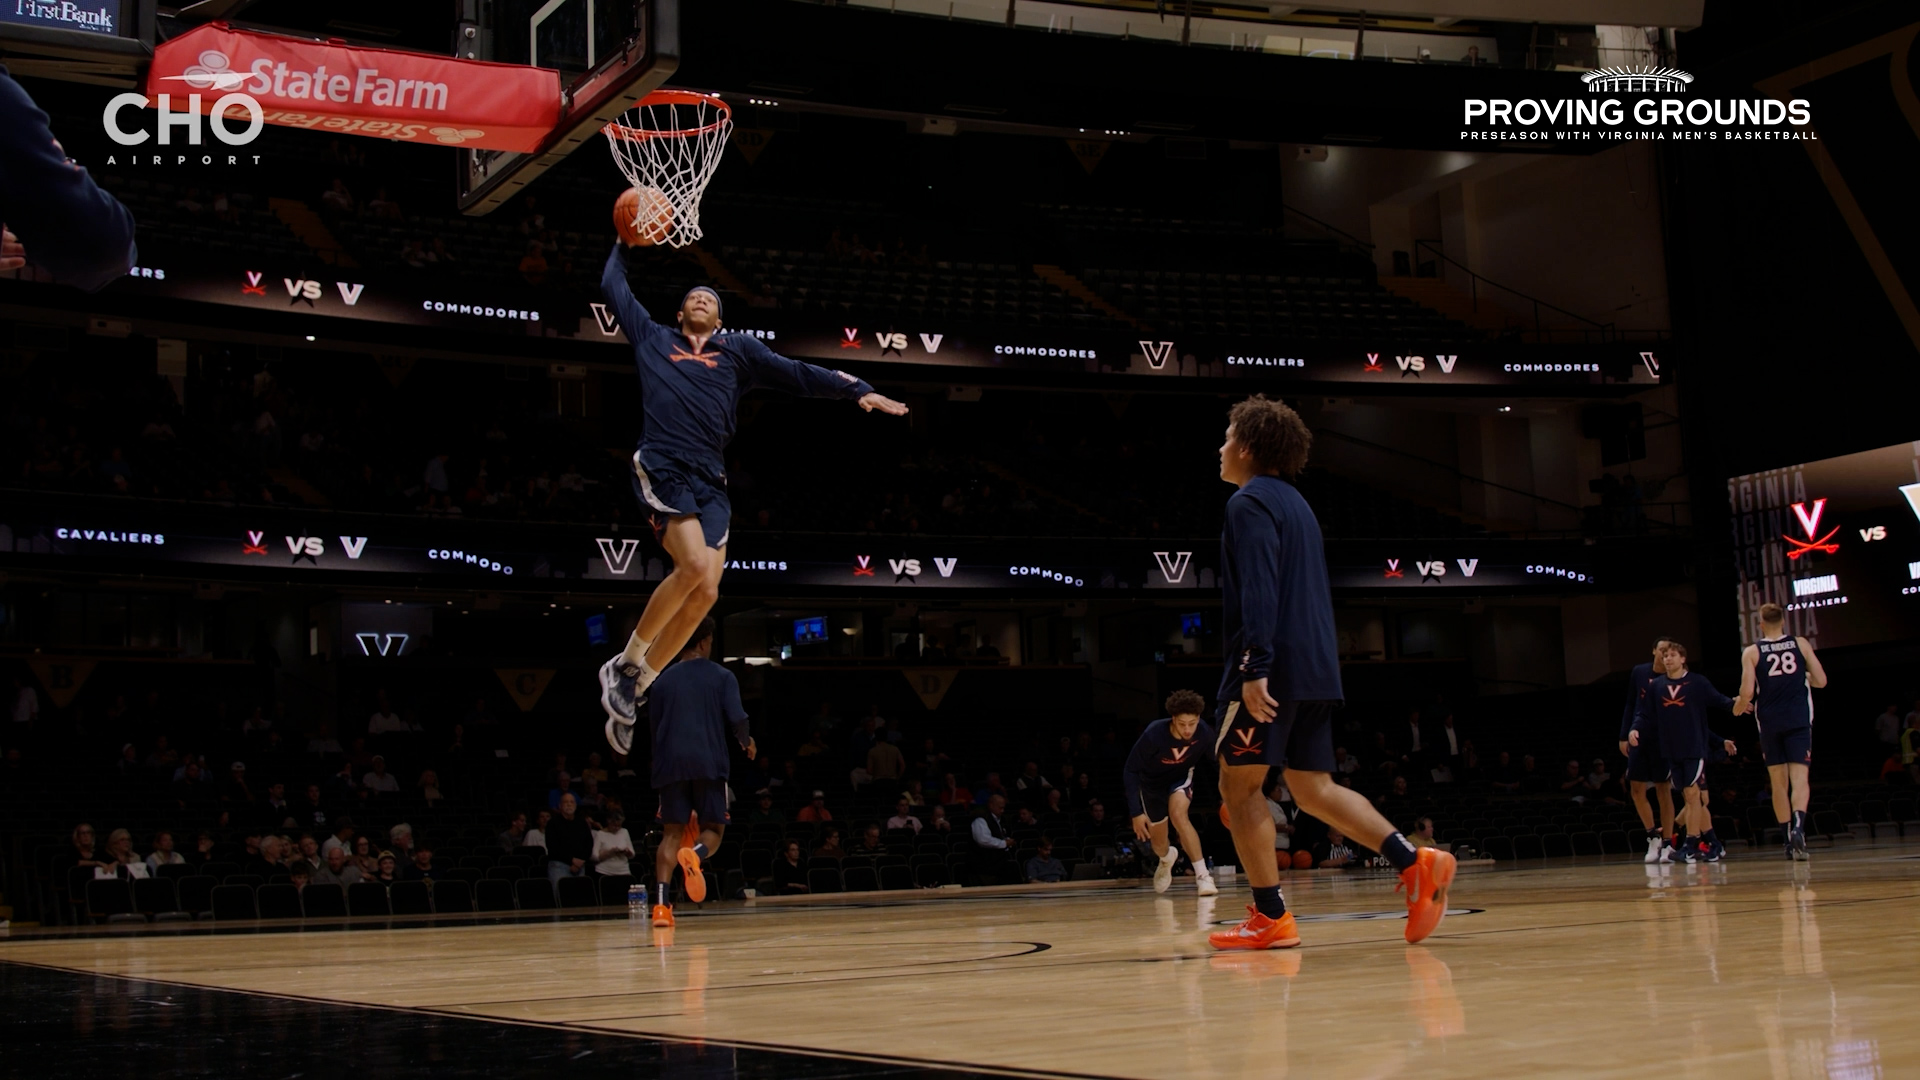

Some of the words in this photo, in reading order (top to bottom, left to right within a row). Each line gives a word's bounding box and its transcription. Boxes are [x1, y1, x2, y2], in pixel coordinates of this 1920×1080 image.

[283, 278, 322, 300] VS
[423, 300, 540, 321] COMMODORES
[875, 332, 908, 350] VS
[994, 345, 1097, 359] COMMODORES
[1227, 355, 1305, 367] CAVALIERS
[1395, 355, 1426, 372] VS
[1503, 363, 1600, 373] COMMODORES
[1791, 498, 1828, 541] V
[56, 527, 165, 545] CAVALIERS
[1859, 525, 1888, 543] VS
[285, 535, 325, 556] VS
[428, 549, 514, 575] COMMODO
[888, 558, 922, 576] VS
[1415, 560, 1447, 577] VS
[1010, 566, 1084, 587] COMMODO
[1793, 575, 1839, 597] VIRGINIA
[1787, 596, 1848, 611] CAVALIERS
[1766, 651, 1797, 677] 28
[516, 673, 536, 695] C
[920, 674, 940, 694] D
